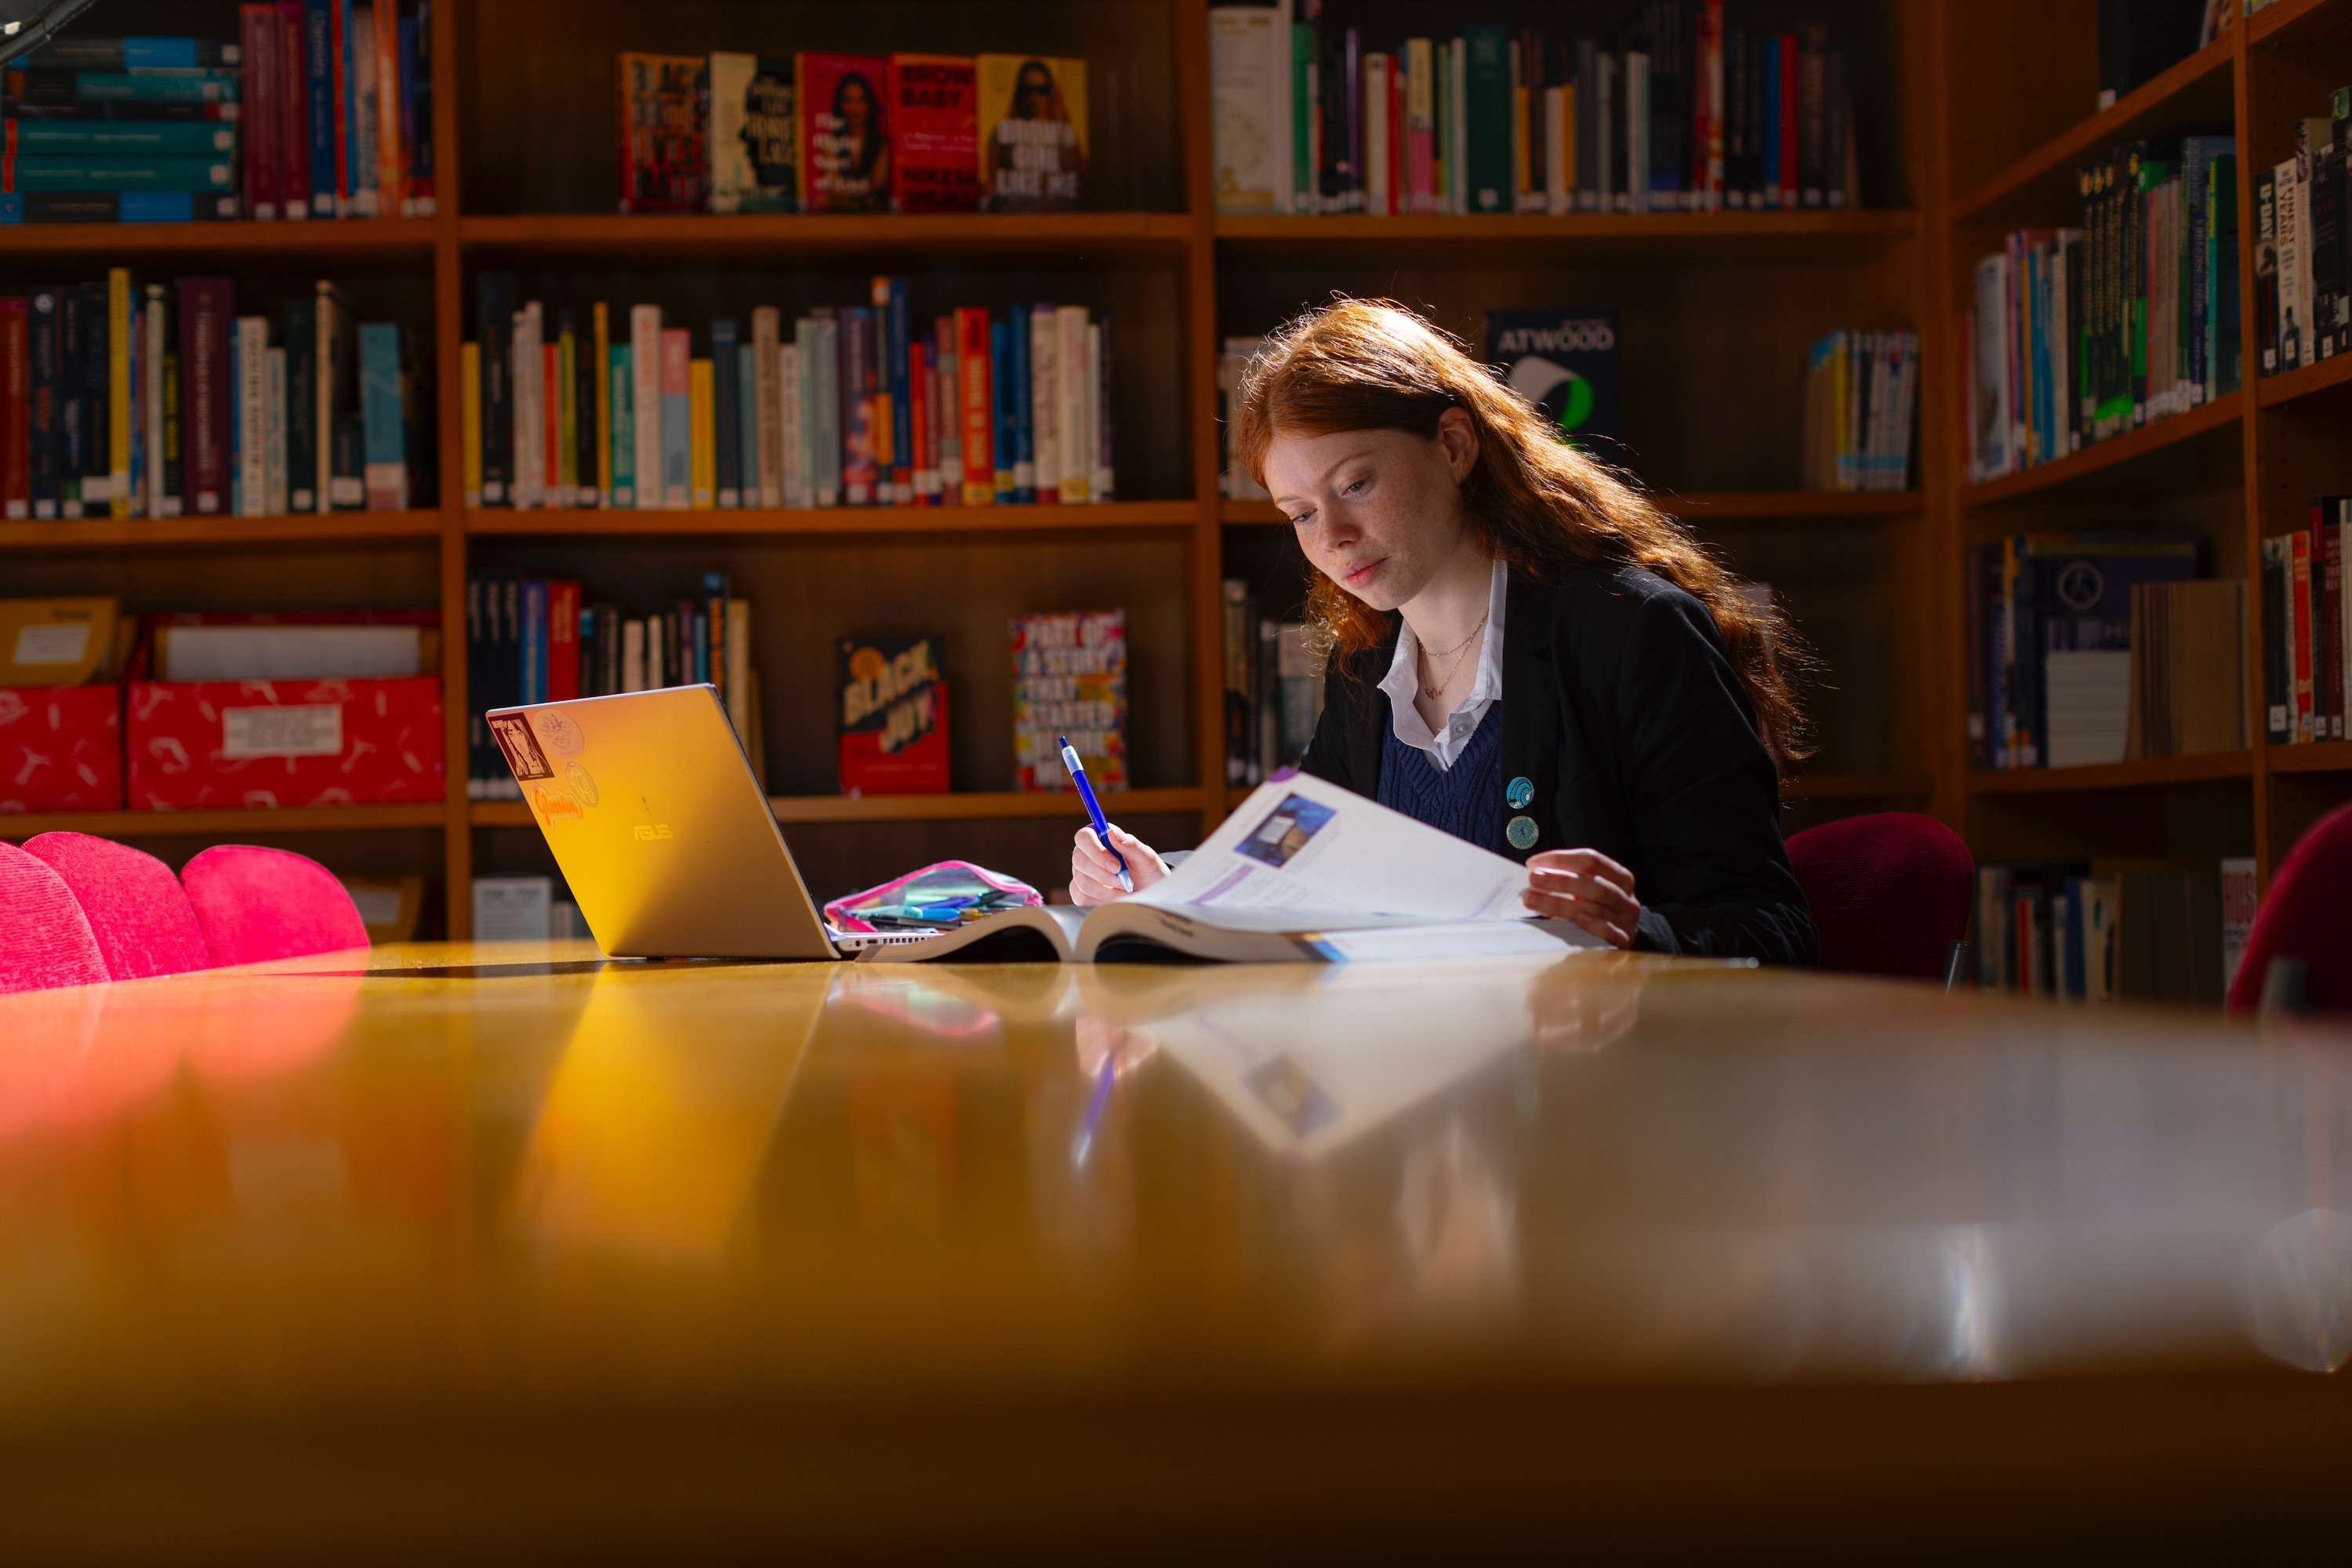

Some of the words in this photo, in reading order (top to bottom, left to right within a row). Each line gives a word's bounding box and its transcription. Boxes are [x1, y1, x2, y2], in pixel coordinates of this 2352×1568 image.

[2279, 191, 2288, 247] YEARS
[1497, 327, 1615, 352] ATWOOD
[843, 639, 931, 728] BLACK
[877, 687, 933, 755] JOY
[633, 823, 674, 841] ASUS
